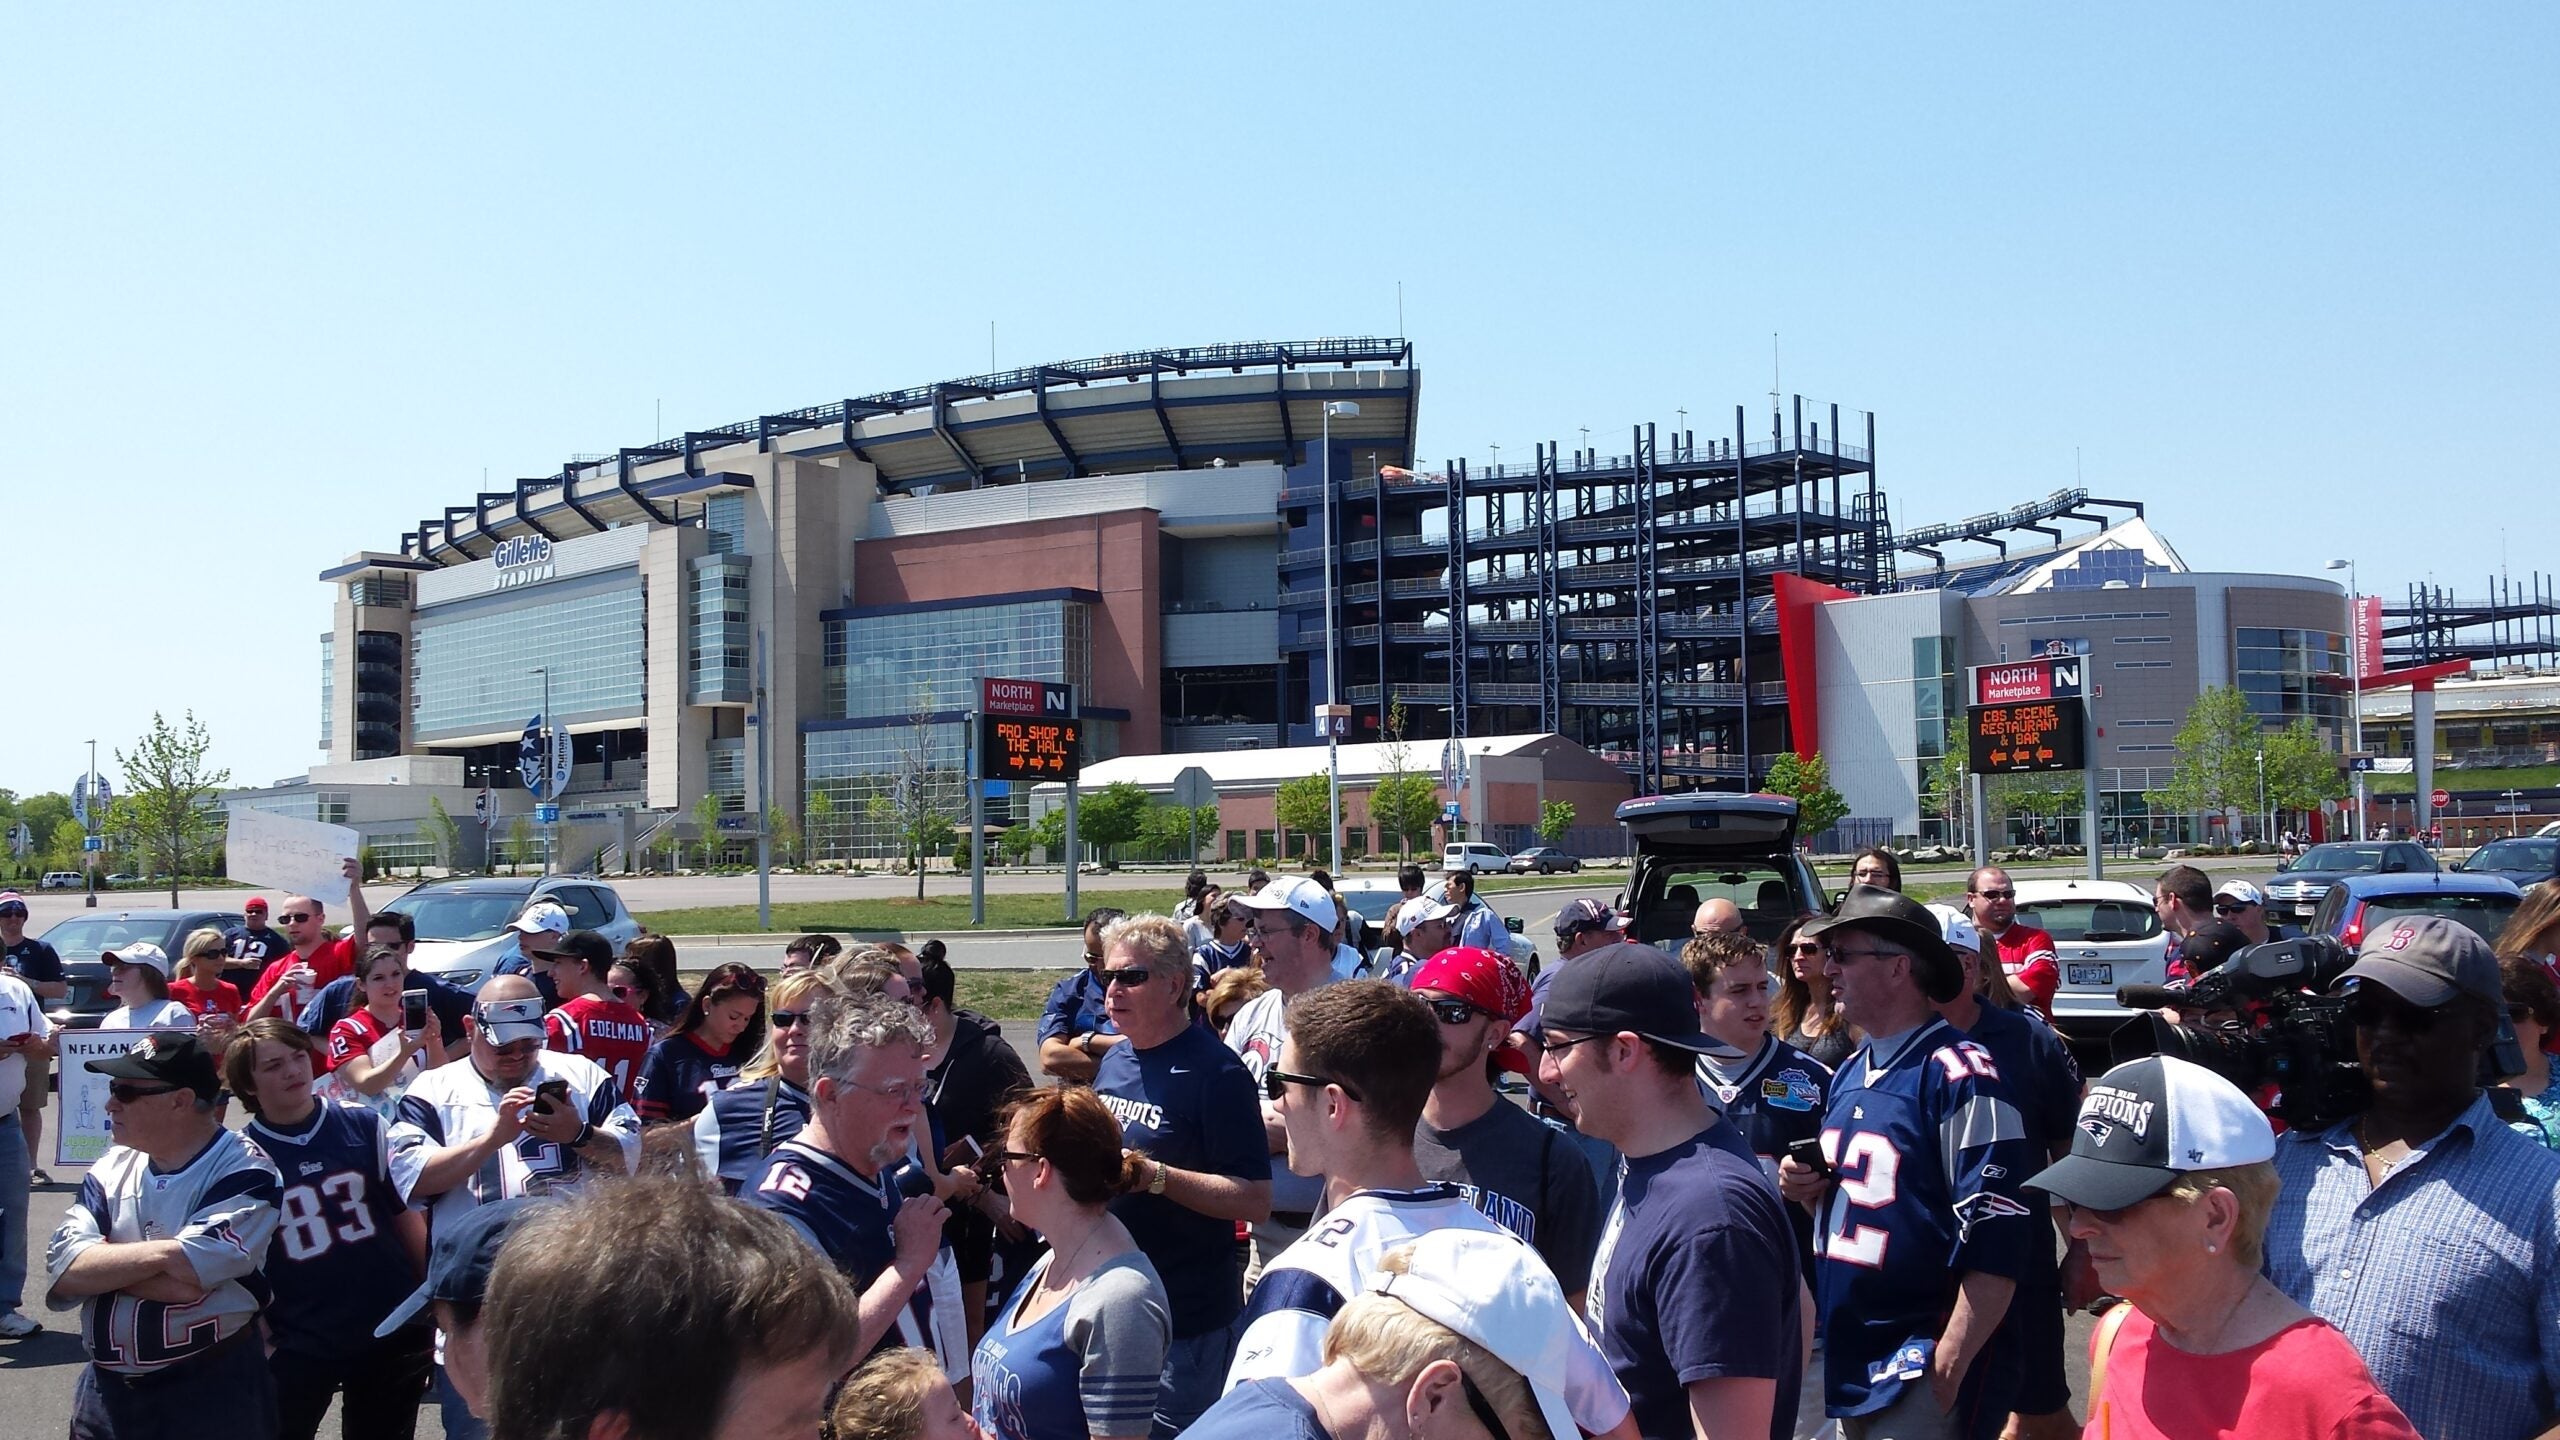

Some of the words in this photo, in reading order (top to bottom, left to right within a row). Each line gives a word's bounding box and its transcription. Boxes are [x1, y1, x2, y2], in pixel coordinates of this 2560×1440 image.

[495, 534, 551, 569] Gillette
[493, 563, 554, 589] STADIUM
[2358, 600, 2369, 625] Bank
[2359, 636, 2370, 678] America
[1990, 667, 2037, 685] NORTH
[2055, 665, 2079, 688] N
[991, 684, 1032, 699] NORTH
[1046, 691, 1065, 710] N
[1988, 685, 2041, 699] Marketplace
[989, 700, 1035, 712] Marketplace
[1983, 710, 2007, 723] CBS
[2015, 705, 2056, 720] SCENE
[998, 724, 1022, 738] PRO
[1029, 726, 1059, 740] SHOP
[1066, 728, 1075, 741] &
[1318, 717, 1326, 734] 4
[1335, 717, 1345, 733] 4
[1981, 718, 2059, 735] RESTAURANT
[1007, 738, 1030, 752] THE
[1037, 740, 1067, 754] HALL
[2000, 735, 2009, 746] &
[2015, 732, 2040, 745] BAR
[557, 732, 565, 769] Putnam
[2357, 759, 2368, 769] 4
[2431, 794, 2448, 802] STOP
[2384, 927, 2417, 951] B
[589, 1019, 644, 1042] EDELMAN
[329, 1036, 349, 1059] 12
[1932, 1040, 2000, 1082] 12
[757, 1162, 813, 1201] 12
[279, 1171, 376, 1261] 83
